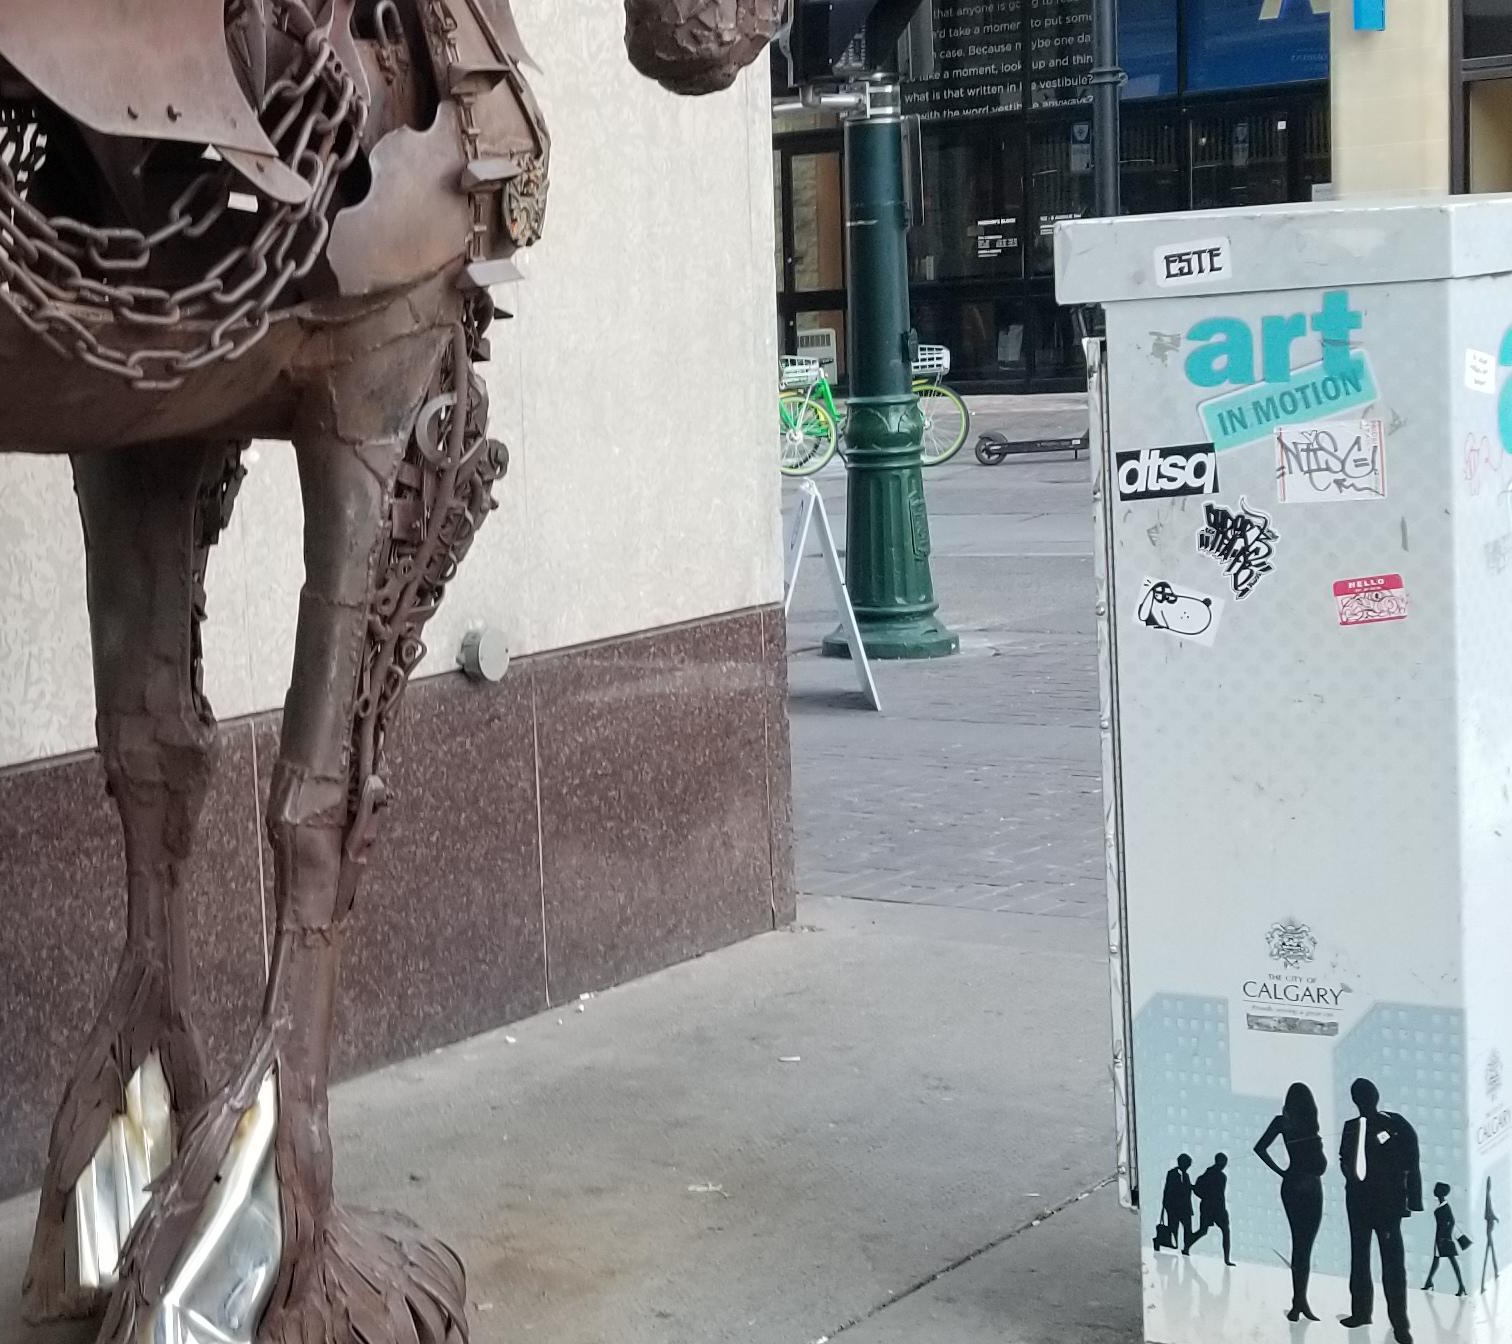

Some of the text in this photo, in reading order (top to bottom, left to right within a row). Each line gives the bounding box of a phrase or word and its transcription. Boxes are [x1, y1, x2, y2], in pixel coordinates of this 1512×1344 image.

[968, 42, 1012, 57] Because
[952, 63, 999, 78] moment,
[1048, 55, 1069, 68] and
[904, 90, 929, 104] what
[932, 89, 941, 101] is
[943, 86, 964, 100] that
[967, 83, 1004, 97] written
[1039, 73, 1094, 90] vestibule?
[1184, 290, 1364, 388] art
[1218, 368, 1362, 436] IN MOTION
[1118, 449, 1216, 494] dtsq
[1348, 578, 1385, 589] HELLO
[1243, 980, 1344, 1006] CALGARY
